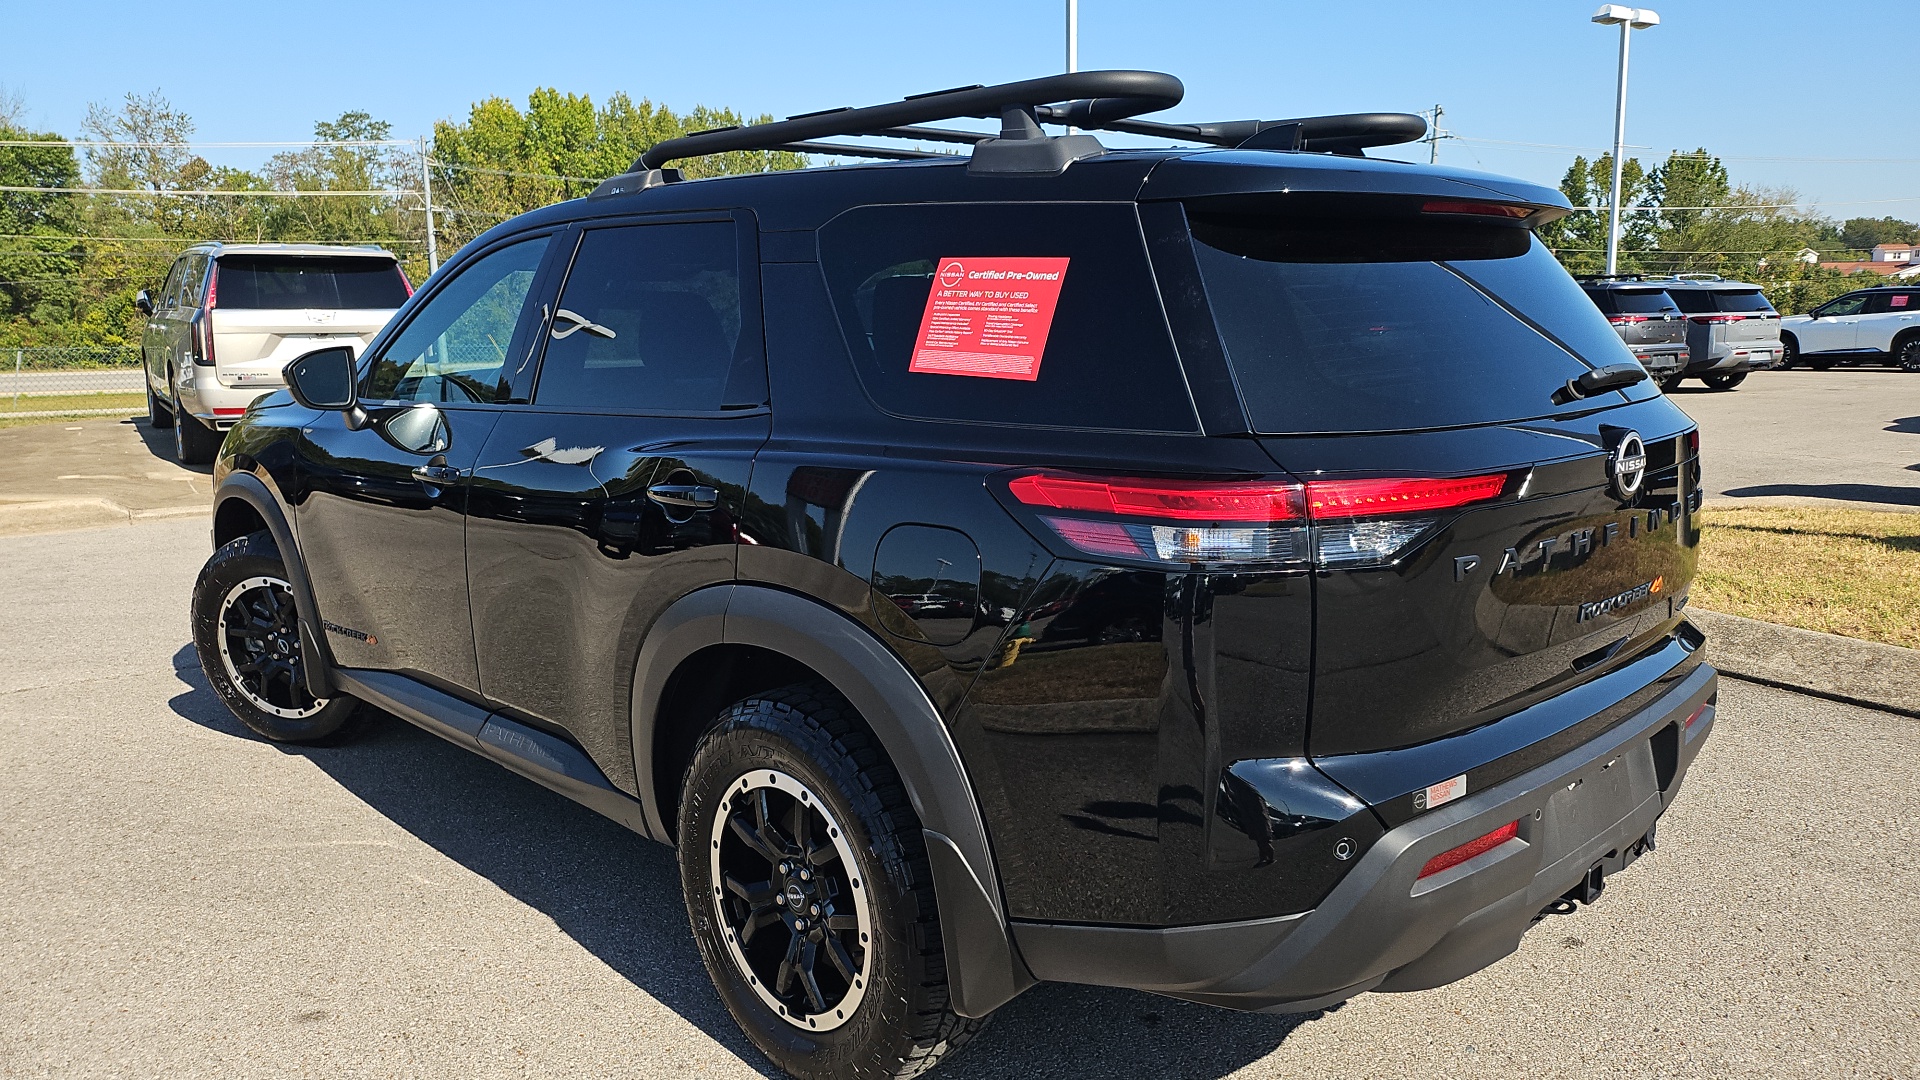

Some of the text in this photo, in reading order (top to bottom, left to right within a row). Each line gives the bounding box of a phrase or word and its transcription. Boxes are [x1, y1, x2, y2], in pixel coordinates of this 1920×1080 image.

[968, 270, 1060, 281] Certified Pre-Owned
[943, 290, 968, 298] BETTER
[968, 290, 983, 298] WAY
[994, 291, 1010, 299] BUY
[1010, 291, 1029, 299] USED
[485, 723, 557, 763] PATHFIN
[1430, 779, 1457, 793] MATHEWS
[1430, 790, 1451, 801] NISSAN
